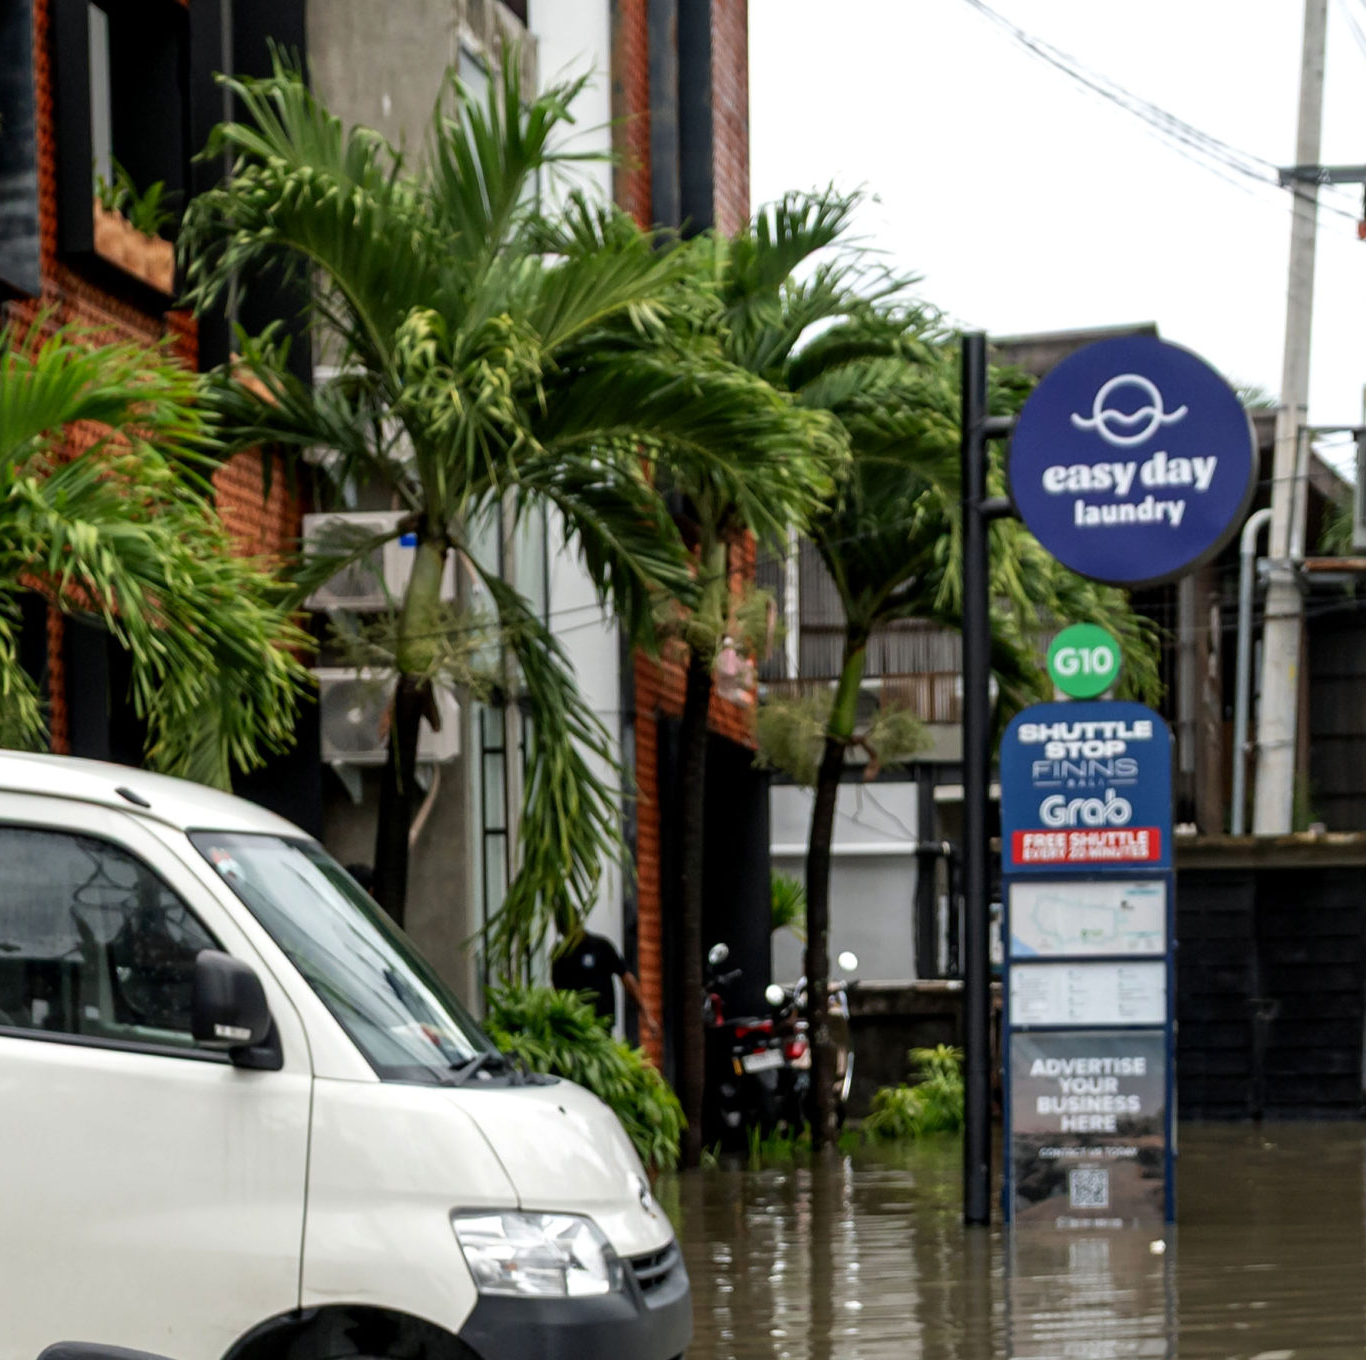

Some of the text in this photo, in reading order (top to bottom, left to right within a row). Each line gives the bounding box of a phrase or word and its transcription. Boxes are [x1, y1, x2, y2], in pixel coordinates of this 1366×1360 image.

[1042, 451, 1218, 496] easy day
[1074, 495, 1186, 527] laundry
[1053, 645, 1114, 676] G10
[1018, 720, 1153, 743] SHUTTLE
[1045, 740, 1126, 759] STOP
[1032, 758, 1138, 778] FINNS
[1039, 788, 1132, 827] Grab
[1023, 831, 1149, 847] FREE SHUTTLE
[1030, 1057, 1147, 1076] ADVERTISE
[1059, 1076, 1118, 1095] YOUR
[1036, 1095, 1141, 1114] BUSINESS
[1060, 1114, 1117, 1132] HERE
